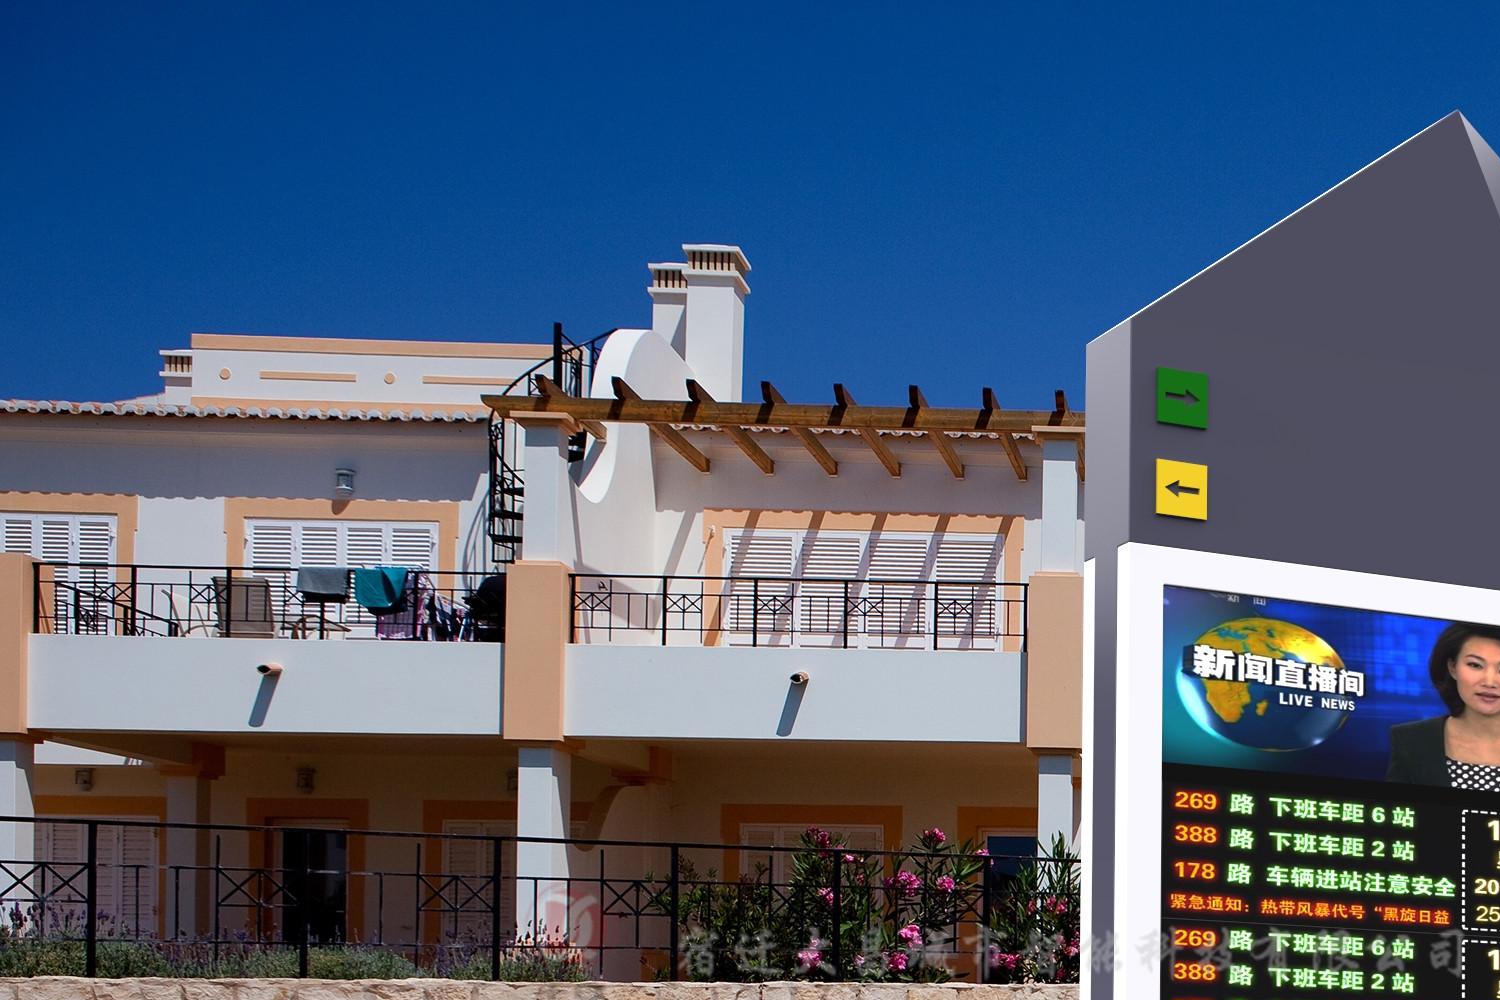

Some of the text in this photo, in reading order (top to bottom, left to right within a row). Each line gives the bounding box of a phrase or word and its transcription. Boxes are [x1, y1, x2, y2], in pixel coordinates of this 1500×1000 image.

[1193, 644, 1365, 697] 新闻直播间
[1279, 692, 1356, 711] LIVE NEWS
[1176, 792, 1414, 827] 269 路 下班车距 6 站
[1176, 826, 1414, 860] 388 路 下班车距 2 站
[1176, 862, 1455, 896] 178 路 车辆进站注意安全
[1175, 930, 1215, 946] 269
[1229, 930, 1253, 950] 路
[1175, 964, 1215, 980] 388
[1229, 965, 1253, 985] 路
